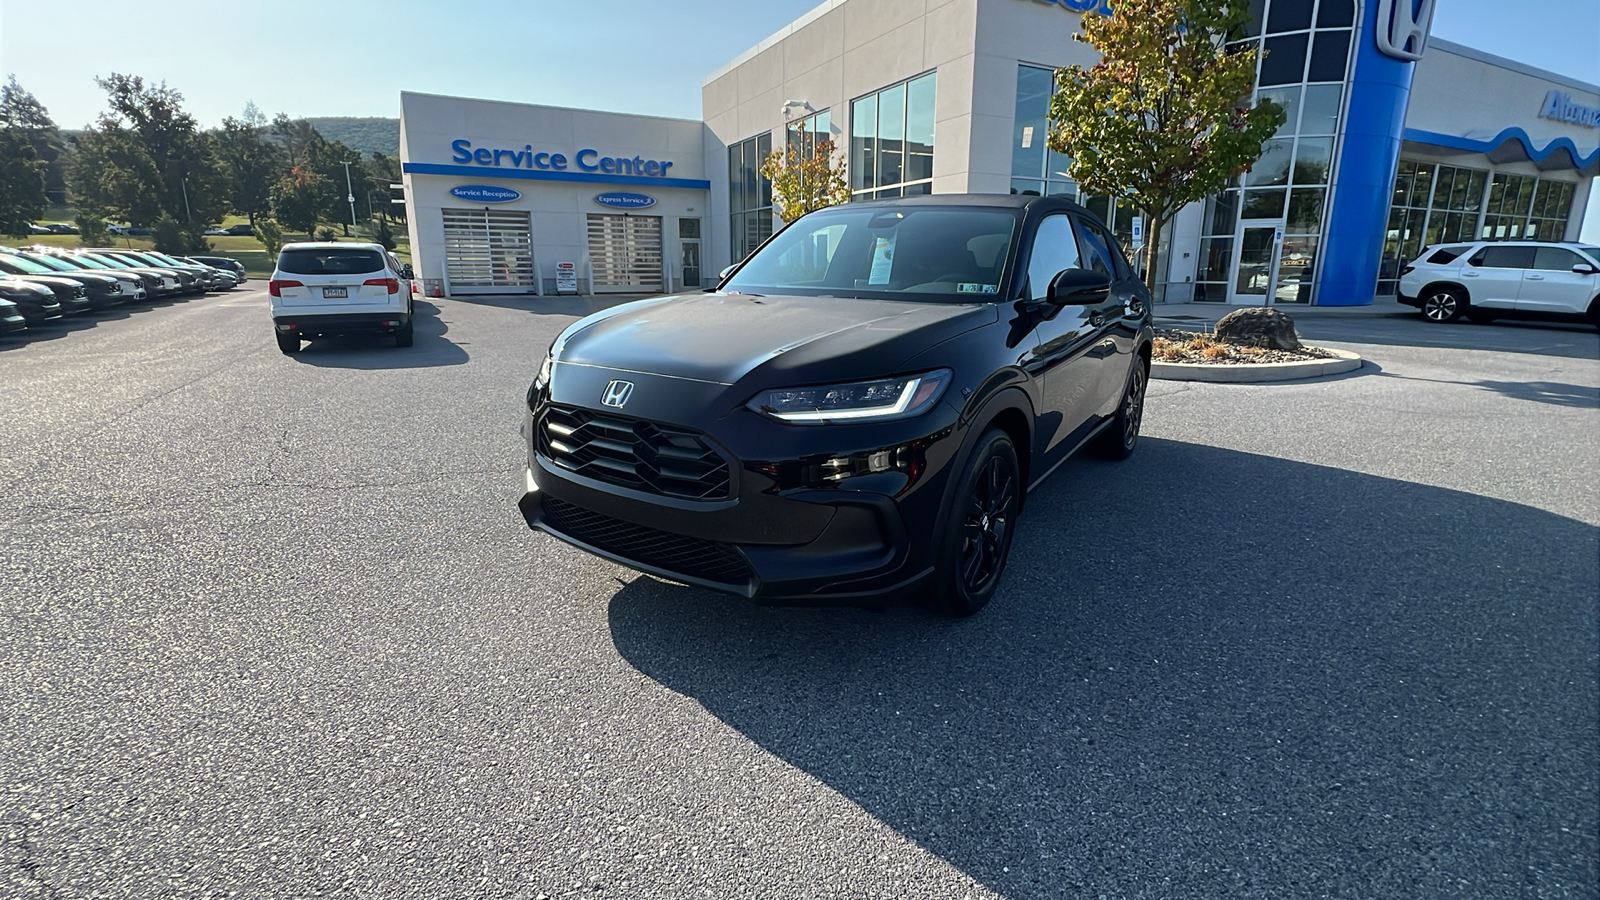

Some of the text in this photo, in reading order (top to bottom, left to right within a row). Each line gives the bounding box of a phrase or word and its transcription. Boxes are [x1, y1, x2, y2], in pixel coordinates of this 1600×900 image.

[451, 139, 674, 176] Service Center
[454, 188, 517, 199] Service Reception
[598, 195, 622, 204] Express
